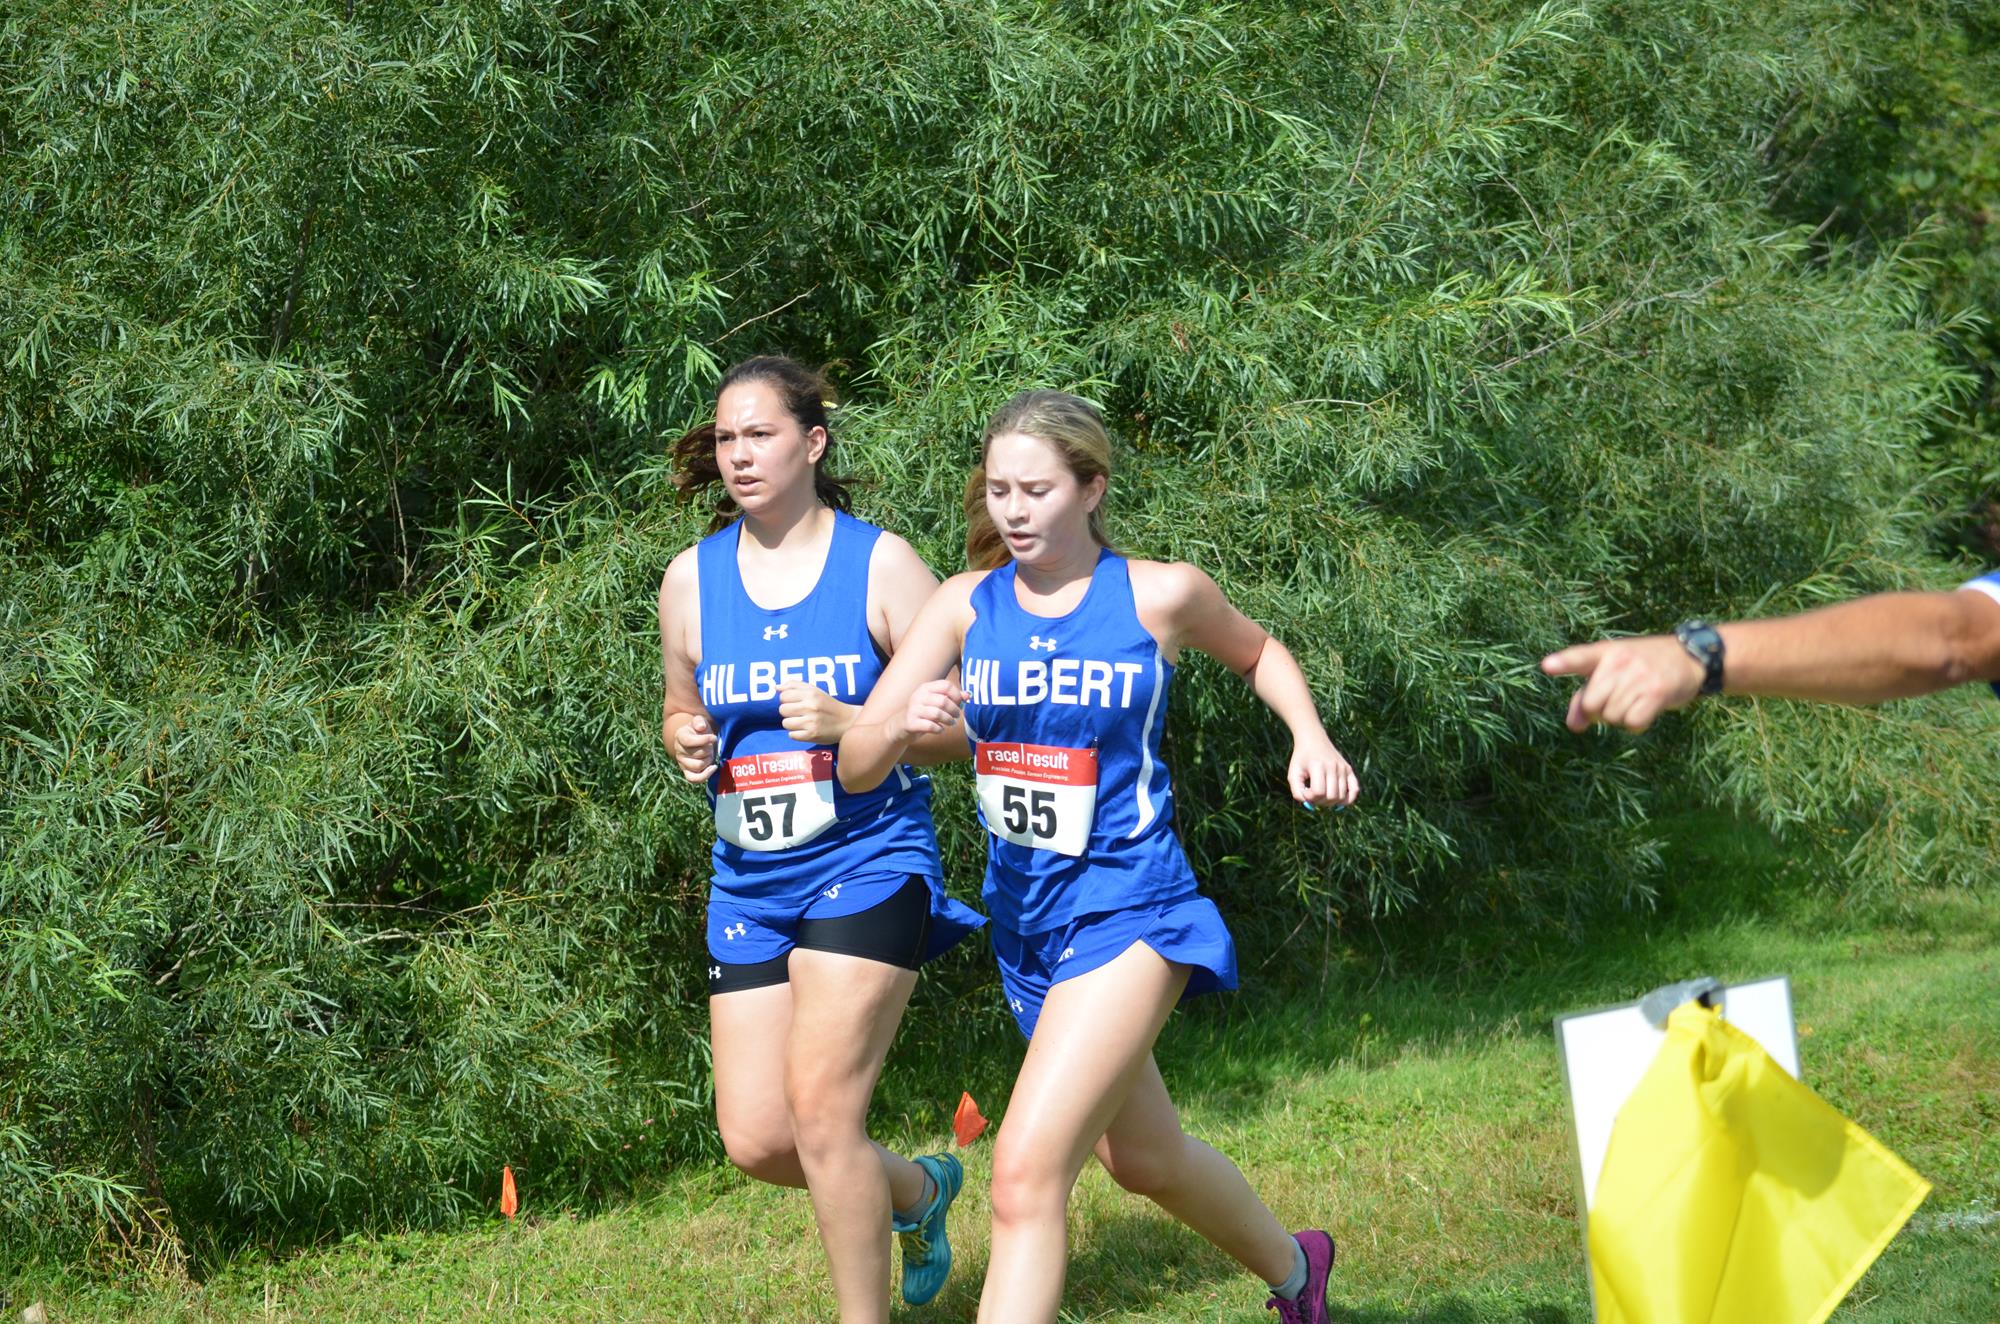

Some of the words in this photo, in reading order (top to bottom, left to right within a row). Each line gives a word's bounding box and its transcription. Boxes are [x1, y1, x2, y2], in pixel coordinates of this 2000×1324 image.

[703, 654, 861, 706] HILBERT
[965, 657, 1142, 709] HILBERT
[732, 762, 756, 778] race
[986, 749, 1019, 764] race
[1026, 751, 1069, 770] result
[743, 792, 797, 841] 57
[1003, 785, 1057, 839] 55
